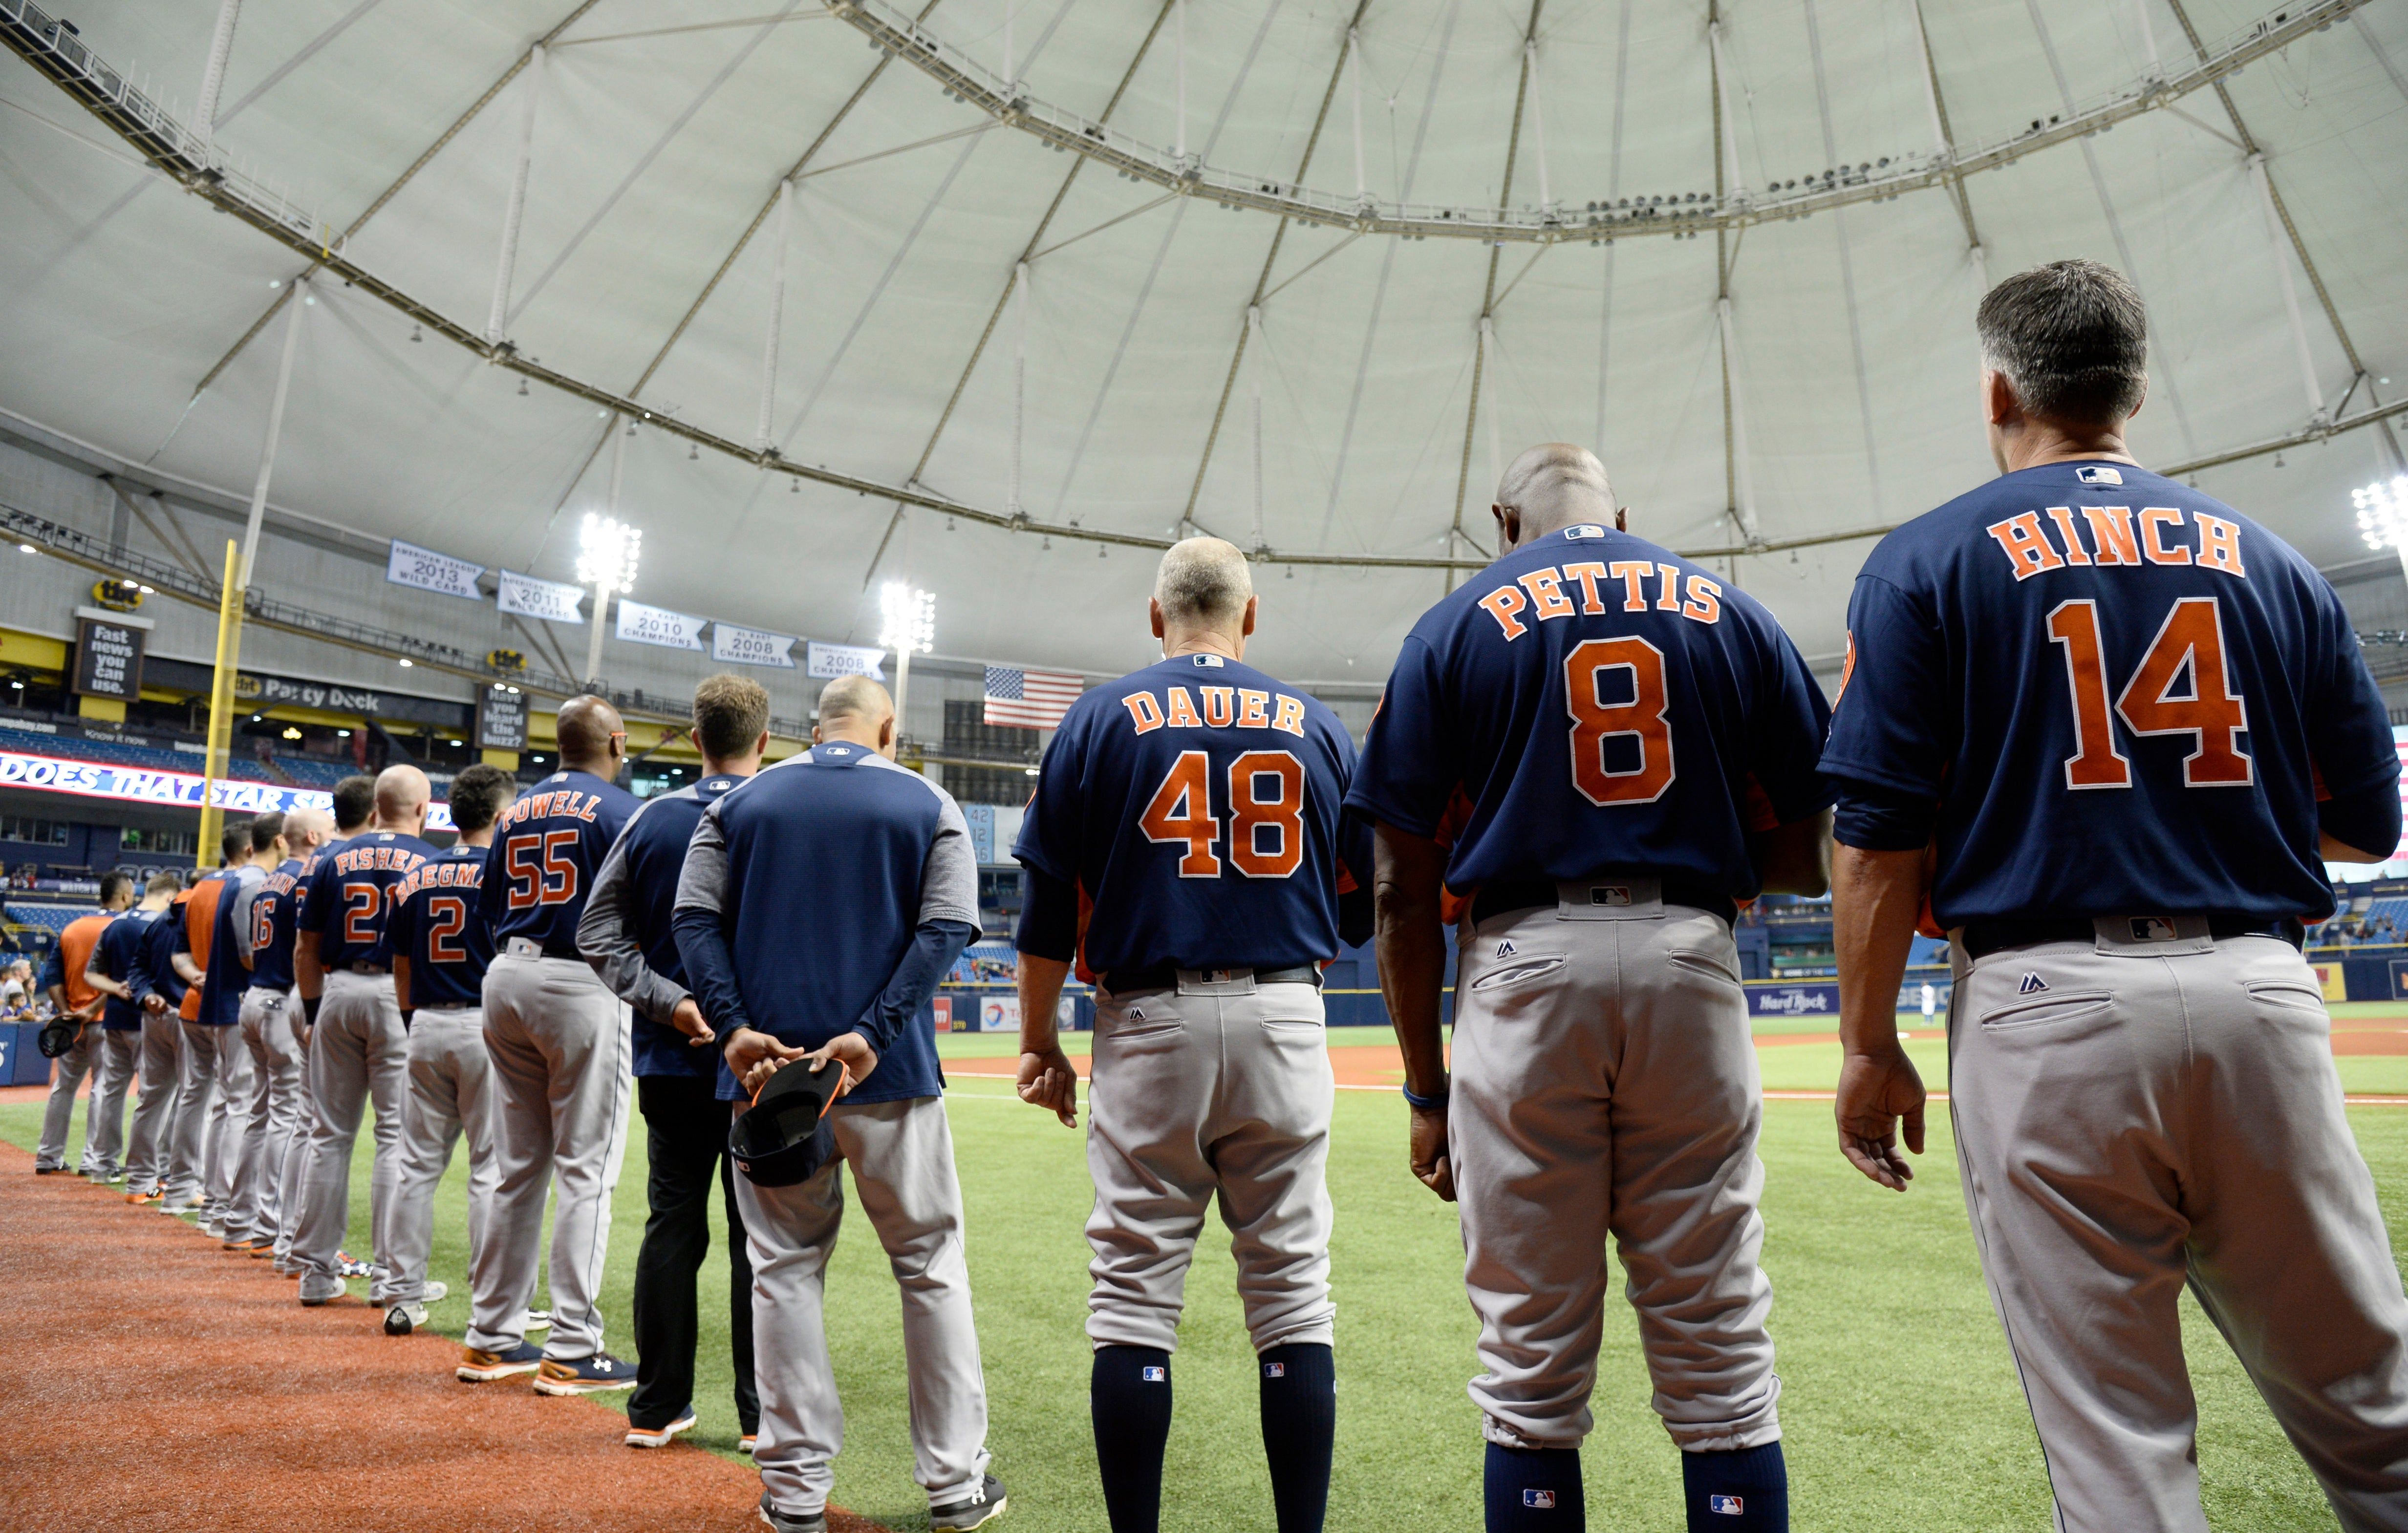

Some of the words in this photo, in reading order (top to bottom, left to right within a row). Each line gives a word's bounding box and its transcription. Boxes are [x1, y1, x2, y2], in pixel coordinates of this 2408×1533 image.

[1986, 505, 2246, 581] HINCH
[396, 547, 441, 563] AMERICAN
[415, 561, 458, 583] 2013
[400, 571, 430, 584] WILD
[435, 580, 467, 595] CARD
[522, 589, 559, 607] 2011
[1477, 560, 1722, 642] PETTIS
[509, 599, 535, 612] WILD
[541, 606, 569, 619] CARD
[95, 625, 129, 644] Fast
[639, 617, 682, 635] 2010
[624, 628, 692, 648] CHAMPIONS
[733, 638, 773, 654] 2008
[91, 640, 134, 658] news
[720, 649, 783, 665] CHAMPIONS
[96, 654, 127, 669] you
[827, 655, 864, 669] 2008
[95, 667, 125, 681] can
[91, 679, 125, 694] use.
[489, 687, 522, 704] Have
[2046, 596, 2254, 790] 14
[329, 688, 380, 712] Deck
[492, 702, 517, 715] you
[484, 710, 524, 726] heard
[1121, 686, 1306, 738] DAUER
[1563, 635, 1676, 807] 8
[85, 728, 116, 742] Know
[116, 734, 124, 743] it
[492, 722, 516, 736] the
[482, 732, 522, 748] buzz?
[0, 757, 102, 790] DOES
[112, 769, 201, 801] THAT
[199, 781, 283, 812] STAR
[502, 790, 602, 832] POWELL
[971, 809, 988, 823] 42
[1138, 750, 1305, 879] 48
[972, 828, 986, 842] 12
[506, 829, 579, 911] 55
[253, 897, 277, 951] 16
[429, 895, 467, 963] 2
[1760, 993, 1795, 1011] Hard
[1794, 990, 1828, 1012] Rock
